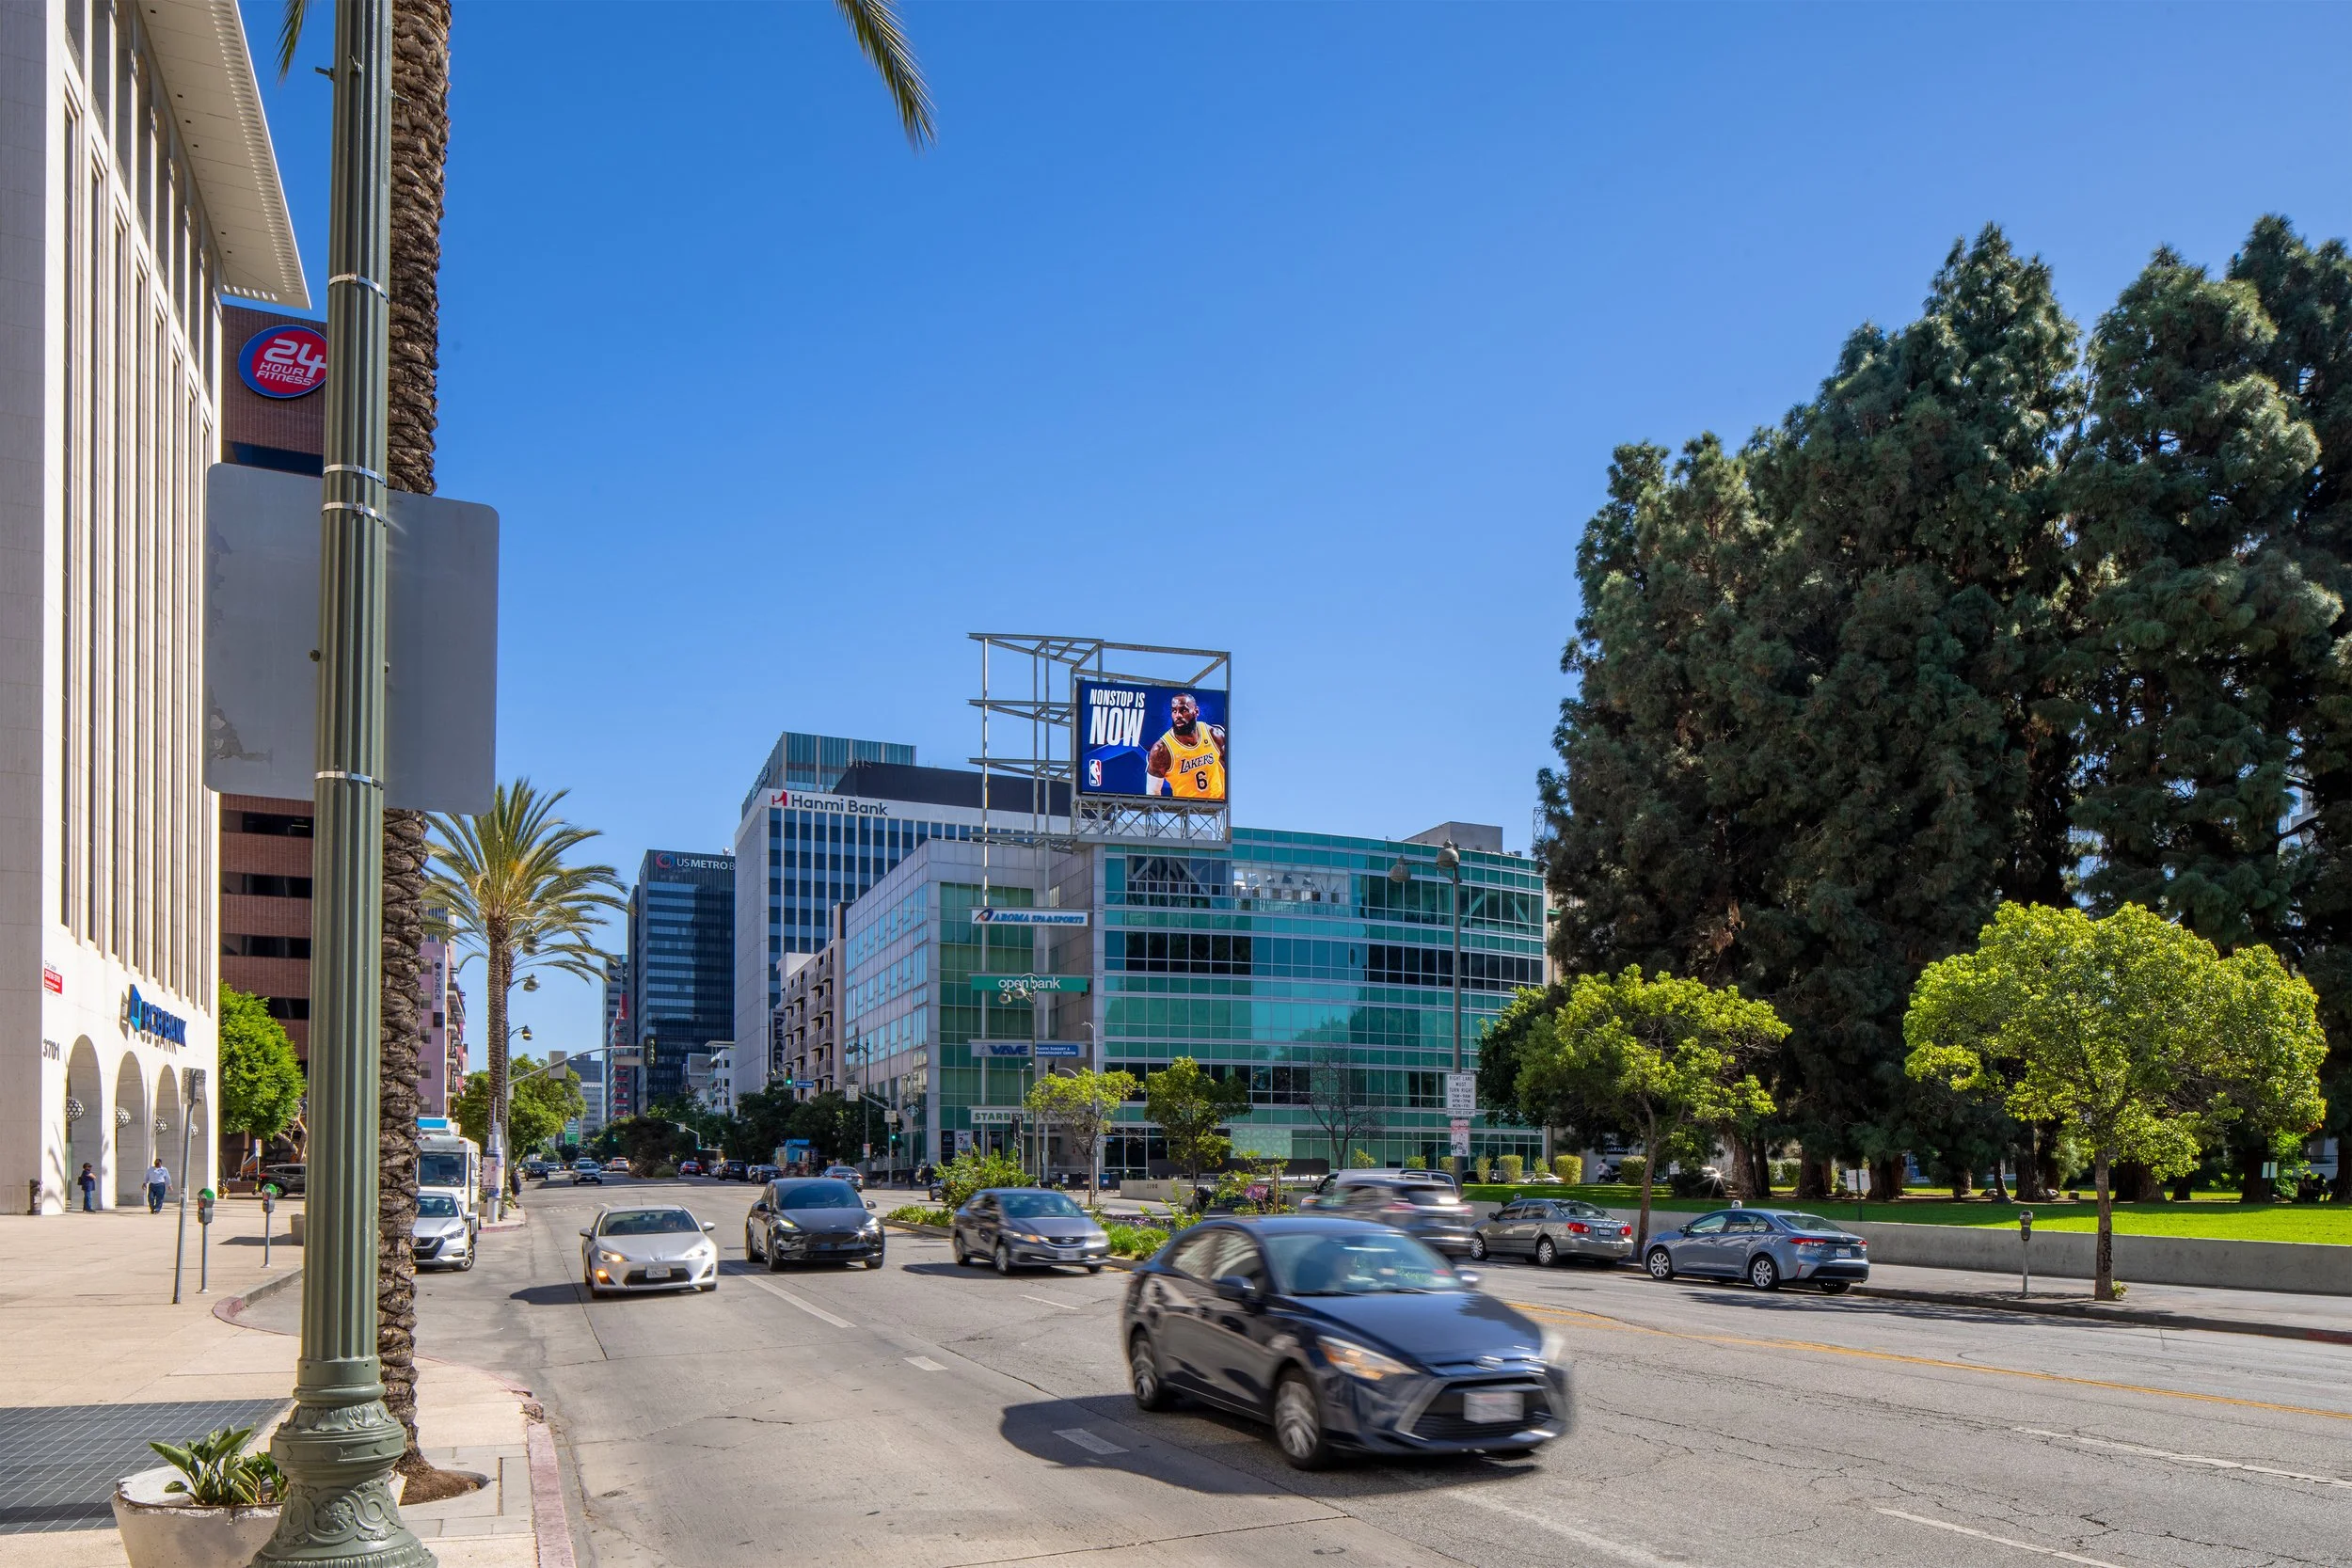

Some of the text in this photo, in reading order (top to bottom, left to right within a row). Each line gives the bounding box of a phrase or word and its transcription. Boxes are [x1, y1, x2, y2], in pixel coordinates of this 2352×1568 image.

[259, 362, 305, 376] HOUR
[263, 338, 326, 378] 24
[256, 370, 313, 386] FITNESS
[1089, 689, 1146, 708] NONSTOP IS
[1089, 706, 1146, 748] NOW
[1180, 752, 1215, 774] LAKERS
[1195, 770, 1208, 792] 6
[791, 794, 888, 816] Hanmi Bank
[676, 858, 690, 867] US
[691, 860, 728, 870] METRO
[993, 913, 1030, 923] AROMA
[141, 1001, 187, 1047] PCB BANK
[43, 1038, 60, 1061] 3701
[975, 1112, 1034, 1121] STARBK
